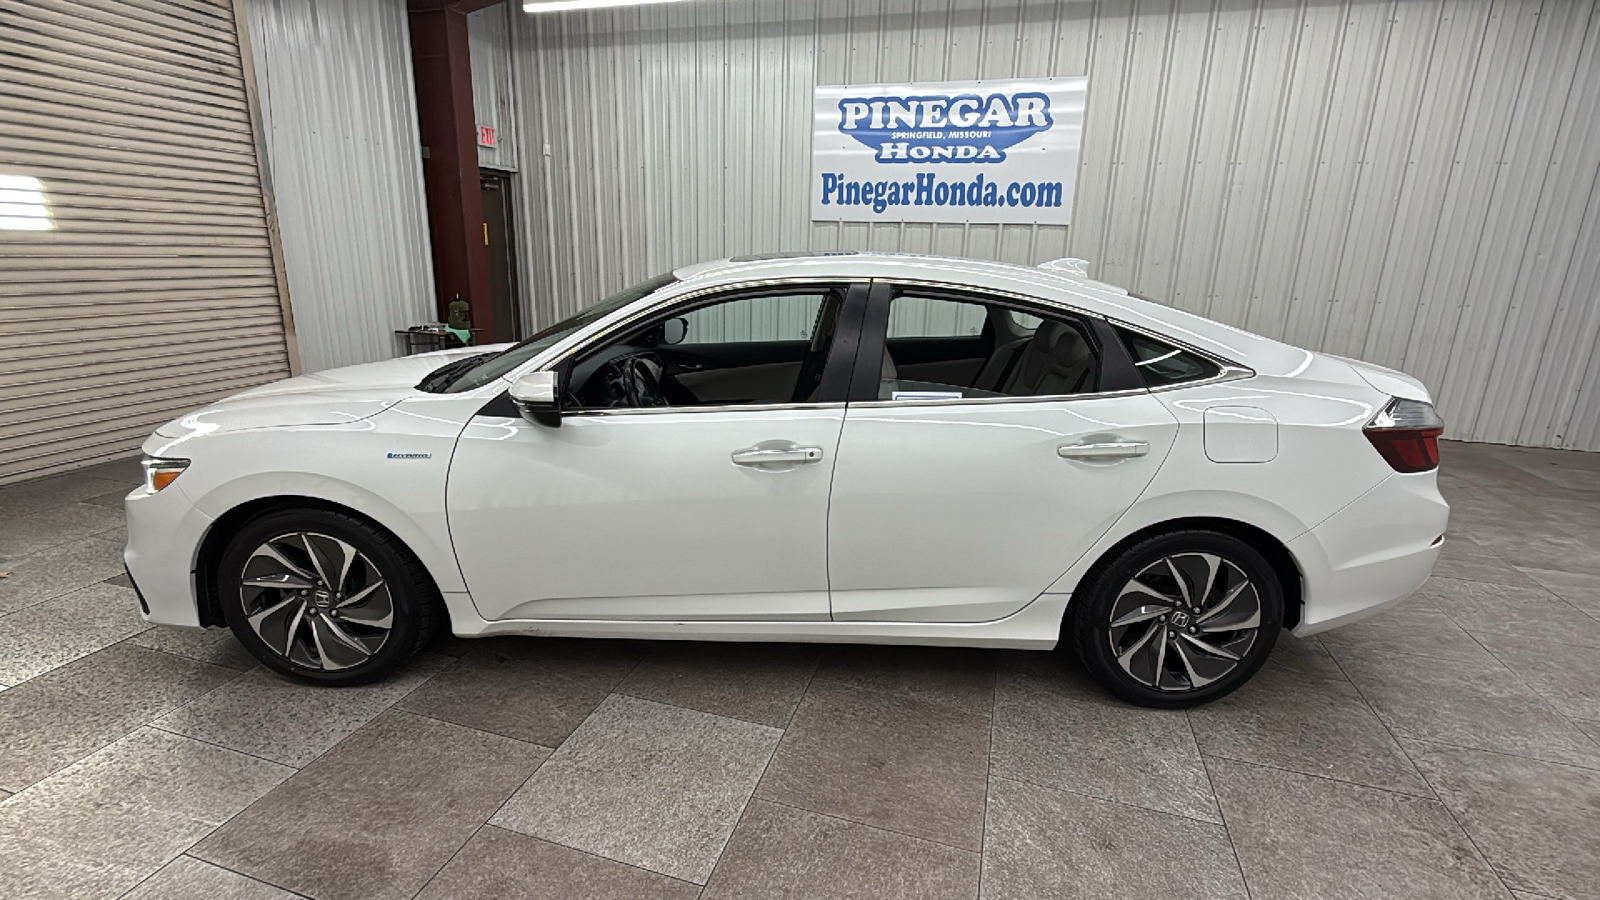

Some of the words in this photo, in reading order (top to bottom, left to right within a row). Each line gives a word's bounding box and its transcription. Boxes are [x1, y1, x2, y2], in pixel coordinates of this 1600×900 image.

[843, 97, 1048, 129] PINEGAR
[480, 126, 495, 145] EXIT
[892, 131, 945, 139] SPRINGFIELD,
[821, 173, 1062, 213] PinegarHonda.com
